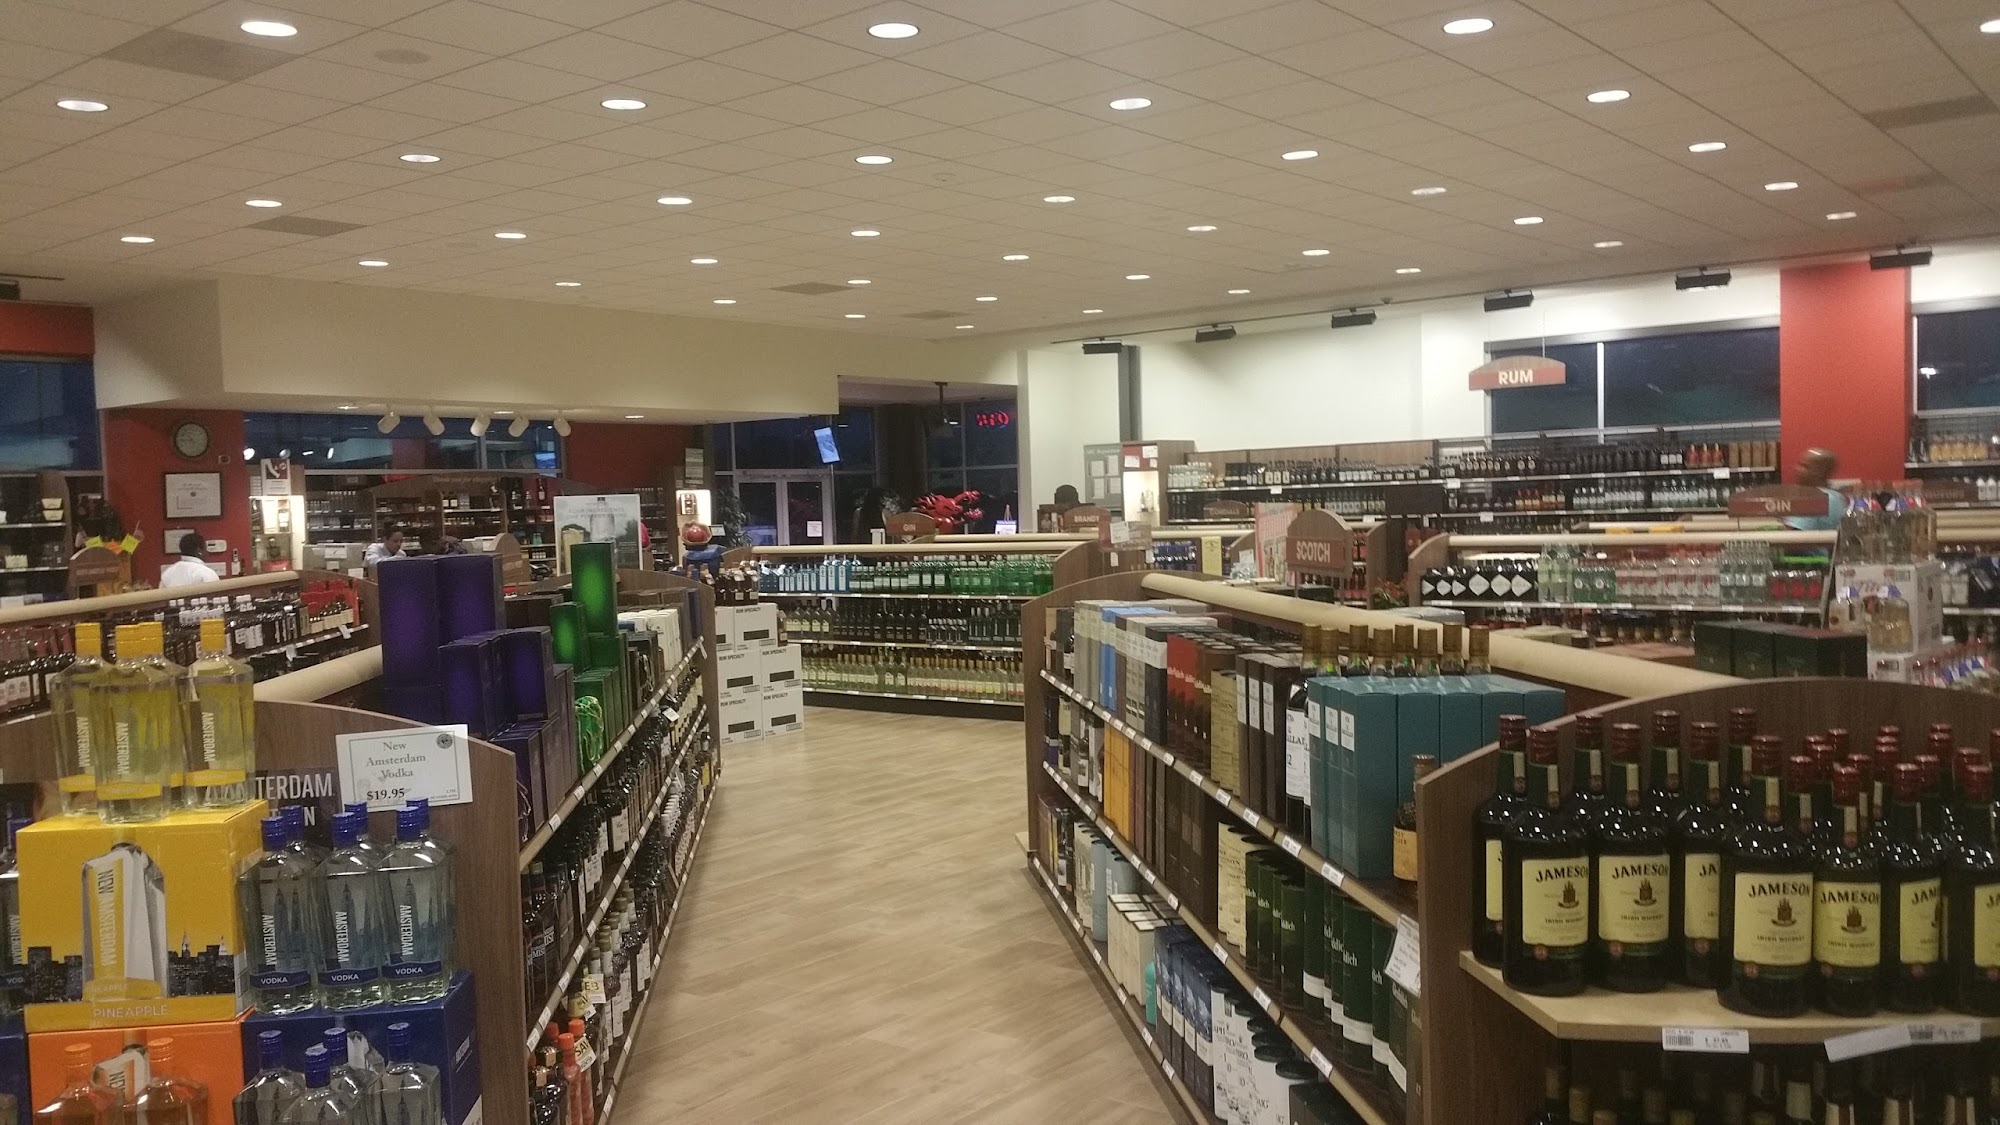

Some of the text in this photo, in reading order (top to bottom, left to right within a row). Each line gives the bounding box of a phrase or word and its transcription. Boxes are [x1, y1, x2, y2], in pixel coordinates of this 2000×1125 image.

[1498, 369, 1533, 385] RUM
[1764, 499, 1791, 512] GIN
[902, 523, 916, 532] GIN
[1296, 540, 1331, 564] SCOTCH
[76, 716, 91, 768] AMSTERDAM
[202, 711, 216, 763] AMSTERDAM
[115, 722, 130, 775] AMSTERDAM
[383, 741, 407, 752] New
[366, 753, 426, 767] Amsterdam
[380, 768, 414, 779] Vodka
[255, 773, 332, 800] TERDAM
[366, 788, 405, 801] $19.95
[1612, 863, 1669, 880] JAMESON
[1748, 881, 1811, 898] JAMESON
[98, 869, 117, 967] NEW AMSTERDAM
[335, 911, 350, 963] AMSTERDAM
[399, 904, 414, 956] AMSTERDAM
[261, 914, 277, 966] AMSTERDAM
[331, 973, 359, 982] VODKA
[395, 967, 423, 975] VODKA
[6, 977, 24, 985] VOD
[261, 976, 288, 985] VODKA
[93, 1004, 168, 1018] PINEAPPLE
